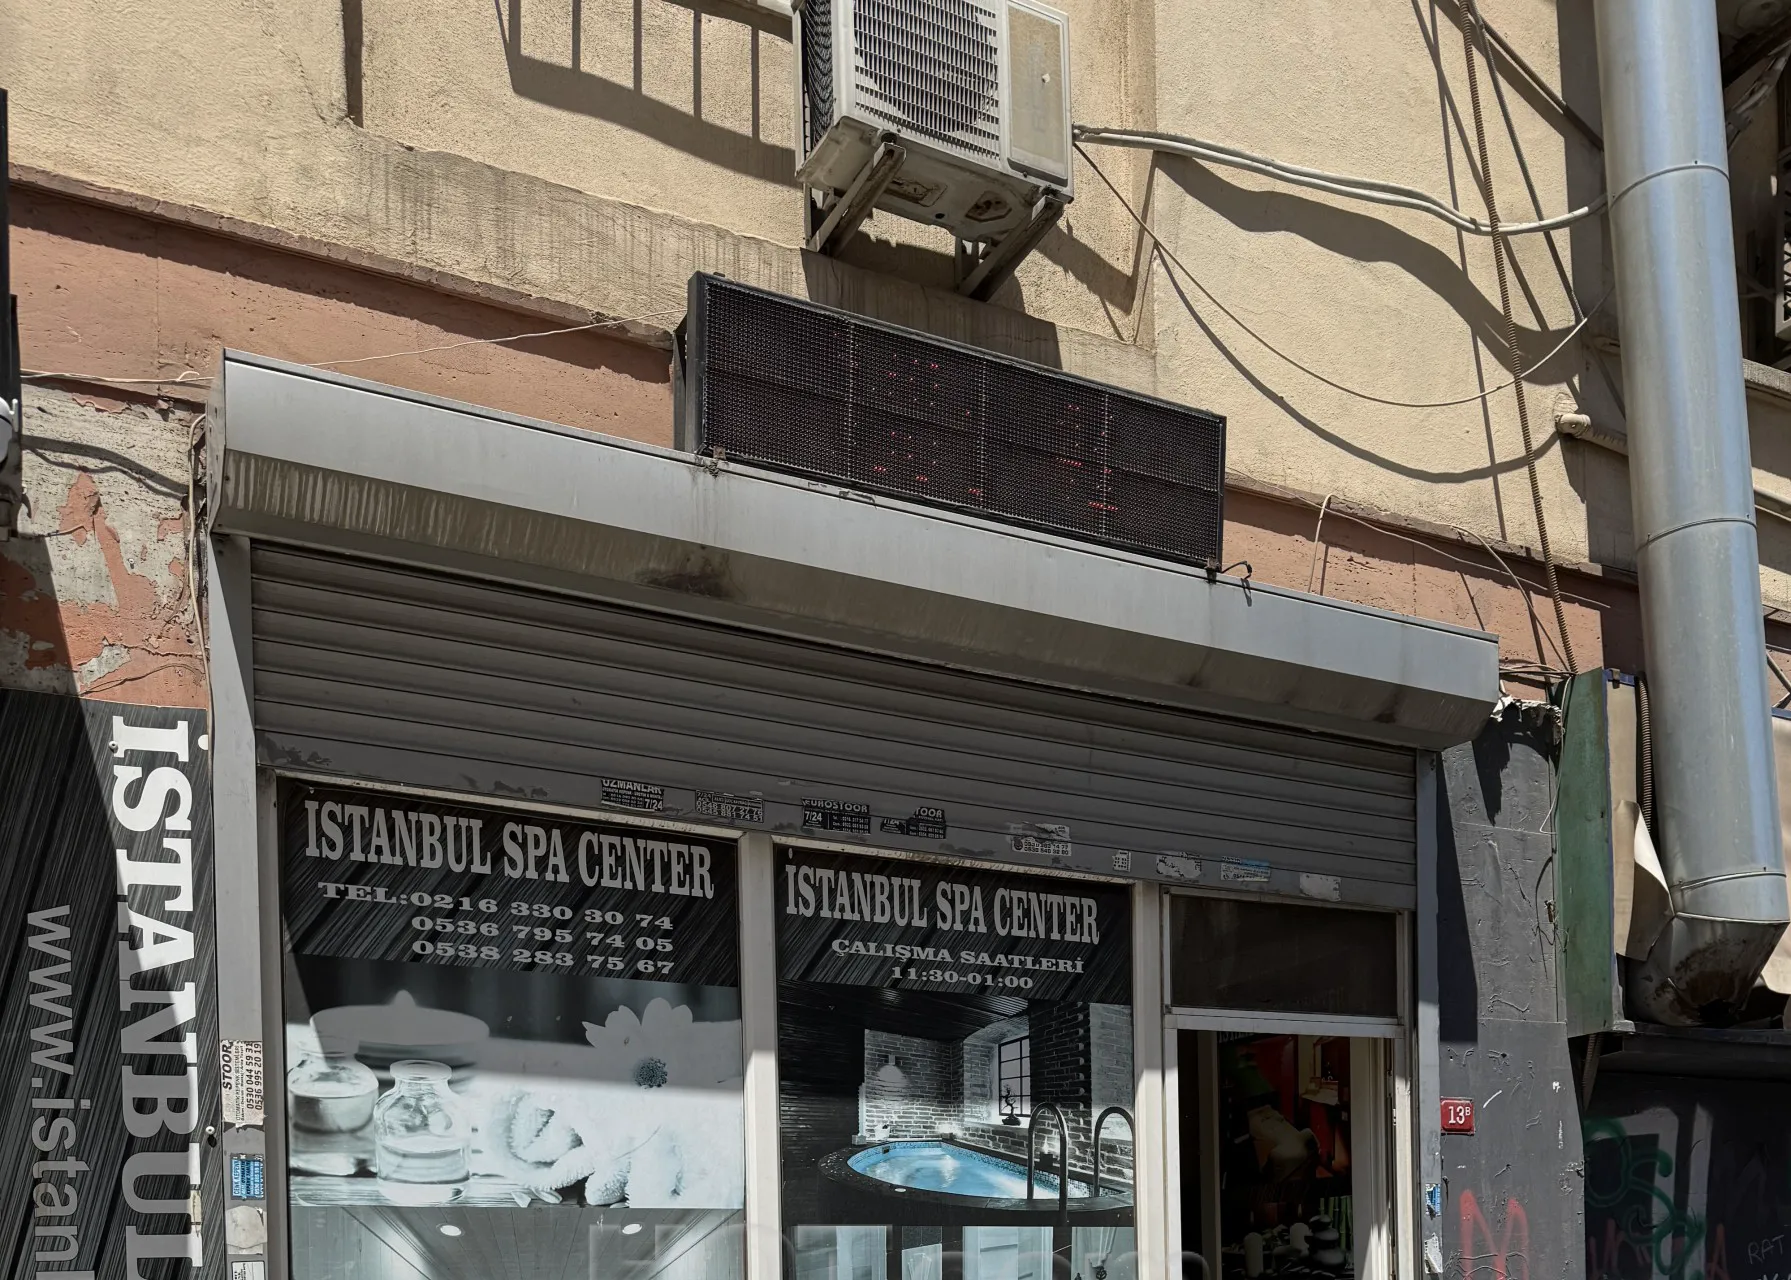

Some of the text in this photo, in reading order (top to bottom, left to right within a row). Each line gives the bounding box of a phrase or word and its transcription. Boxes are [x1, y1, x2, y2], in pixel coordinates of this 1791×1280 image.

[645, 798, 663, 811] 7/24
[804, 811, 823, 822] 7/24
[502, 822, 570, 884] SPA
[577, 831, 715, 900] CENTER
[785, 847, 1101, 945] İSTANBUL SPA CENTER
[510, 901, 574, 921] 330
[584, 908, 625, 926] 30
[635, 913, 674, 931] 74
[411, 916, 674, 953] 0536 795 74 05
[411, 939, 675, 975] 0538 283 75 67
[831, 938, 1085, 974] ÇALIŞMA SAATLERİ
[891, 966, 1034, 990] 11:30-01:00
